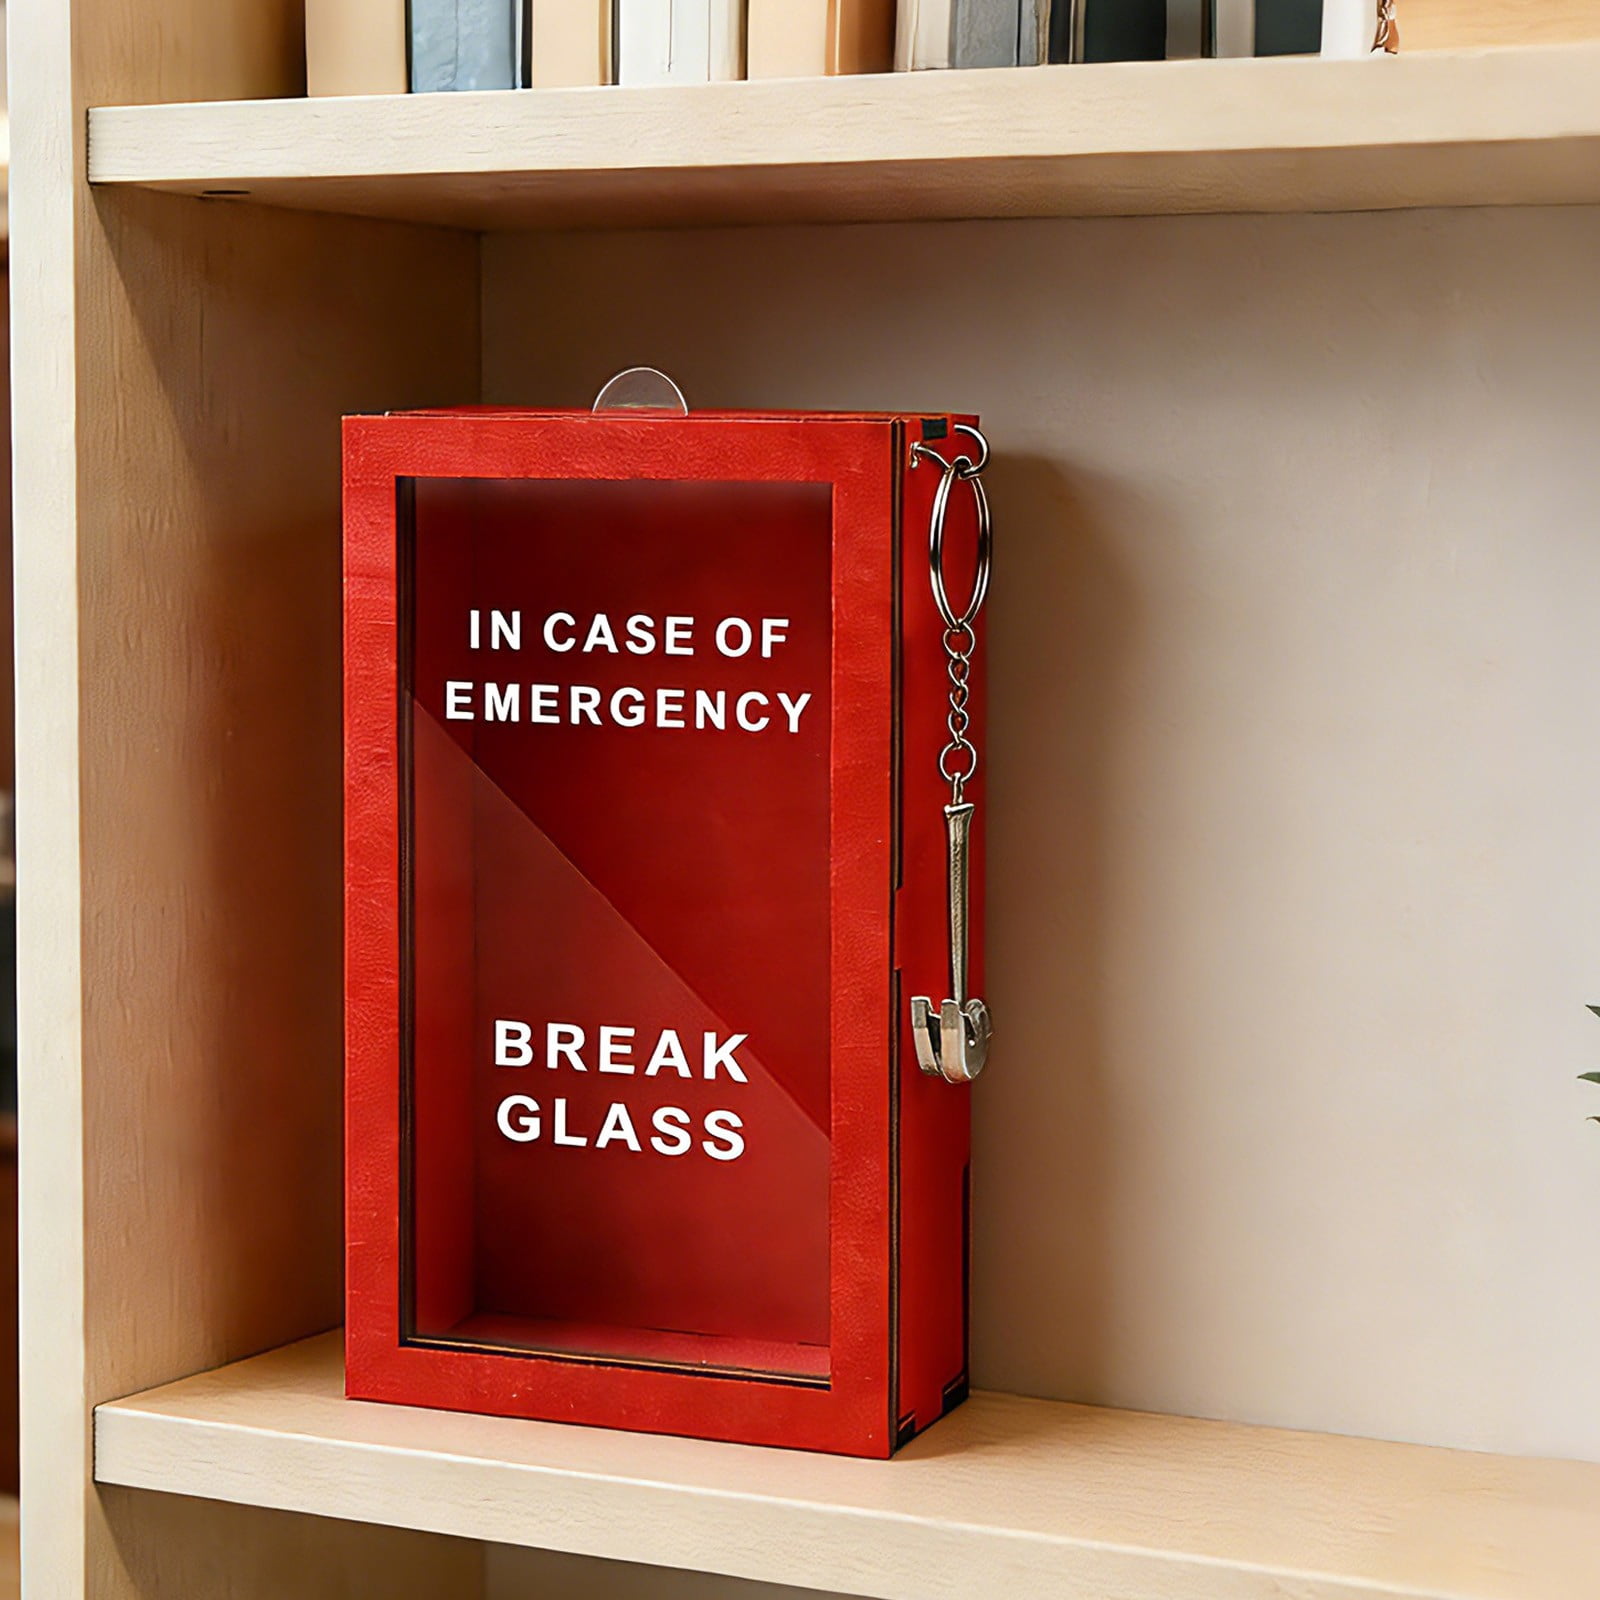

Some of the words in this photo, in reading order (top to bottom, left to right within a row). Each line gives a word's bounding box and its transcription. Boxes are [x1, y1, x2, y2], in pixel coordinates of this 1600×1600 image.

[470, 609, 521, 650] IN
[543, 612, 694, 657] CASE
[715, 617, 789, 658] OF
[446, 681, 812, 734] EMERGENCY
[494, 1019, 749, 1084] BREAK
[496, 1094, 746, 1162] GLASS
